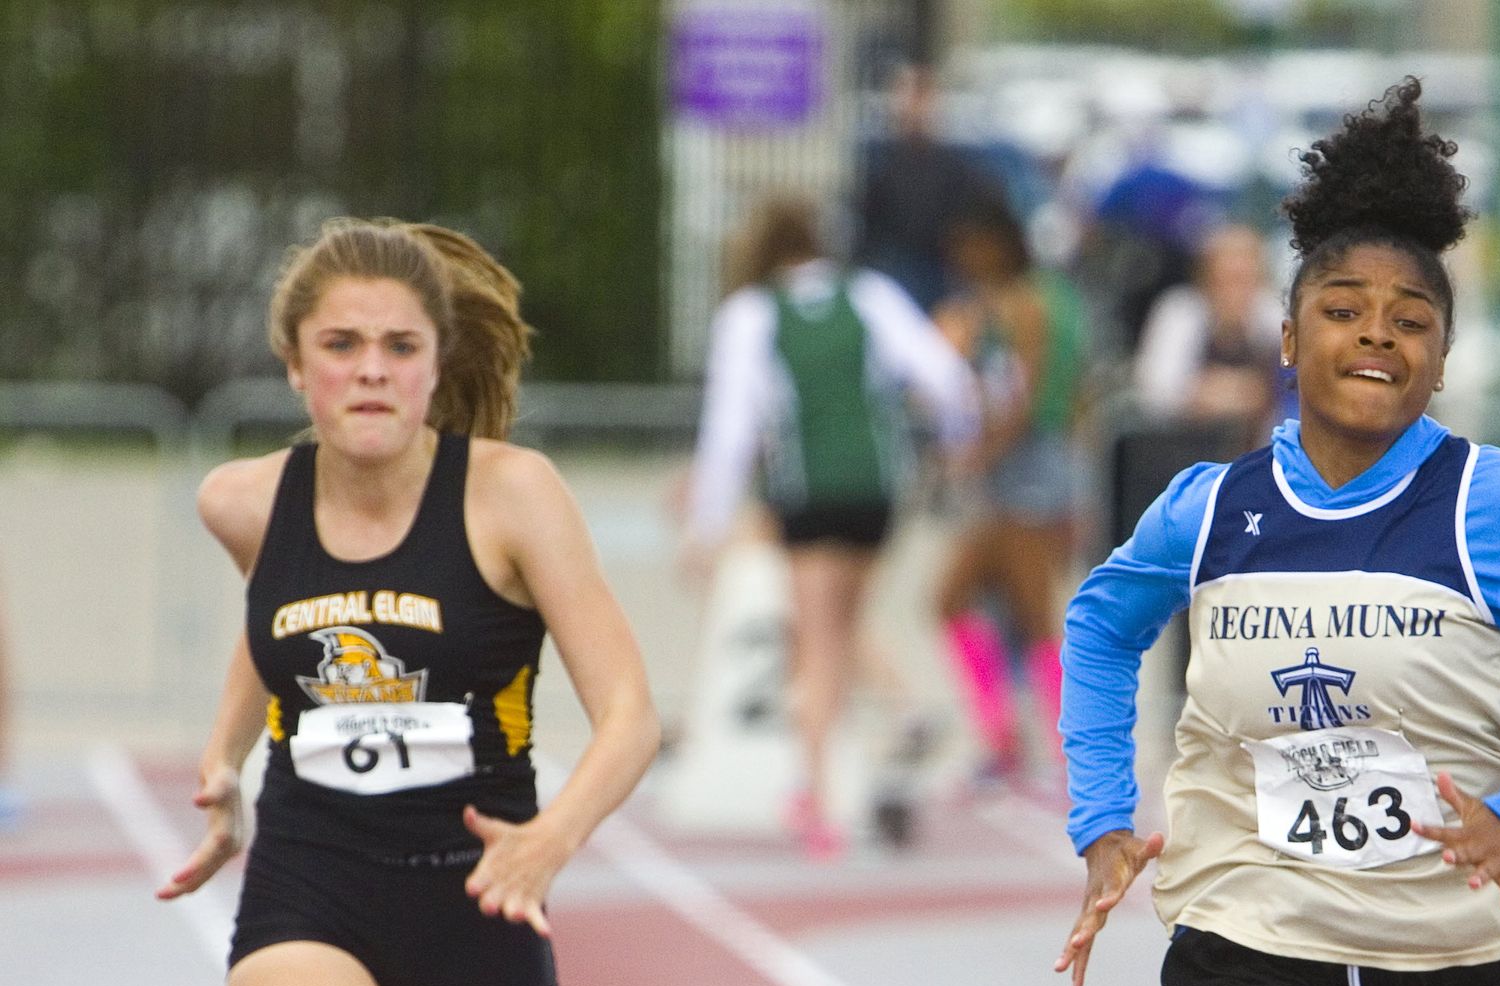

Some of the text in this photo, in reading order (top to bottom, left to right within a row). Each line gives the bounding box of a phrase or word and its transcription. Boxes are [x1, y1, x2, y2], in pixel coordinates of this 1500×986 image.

[272, 591, 442, 639] CENTRAL ELGIN
[1209, 604, 1446, 640] REGINA MUNDI
[1287, 786, 1411, 855] 463
